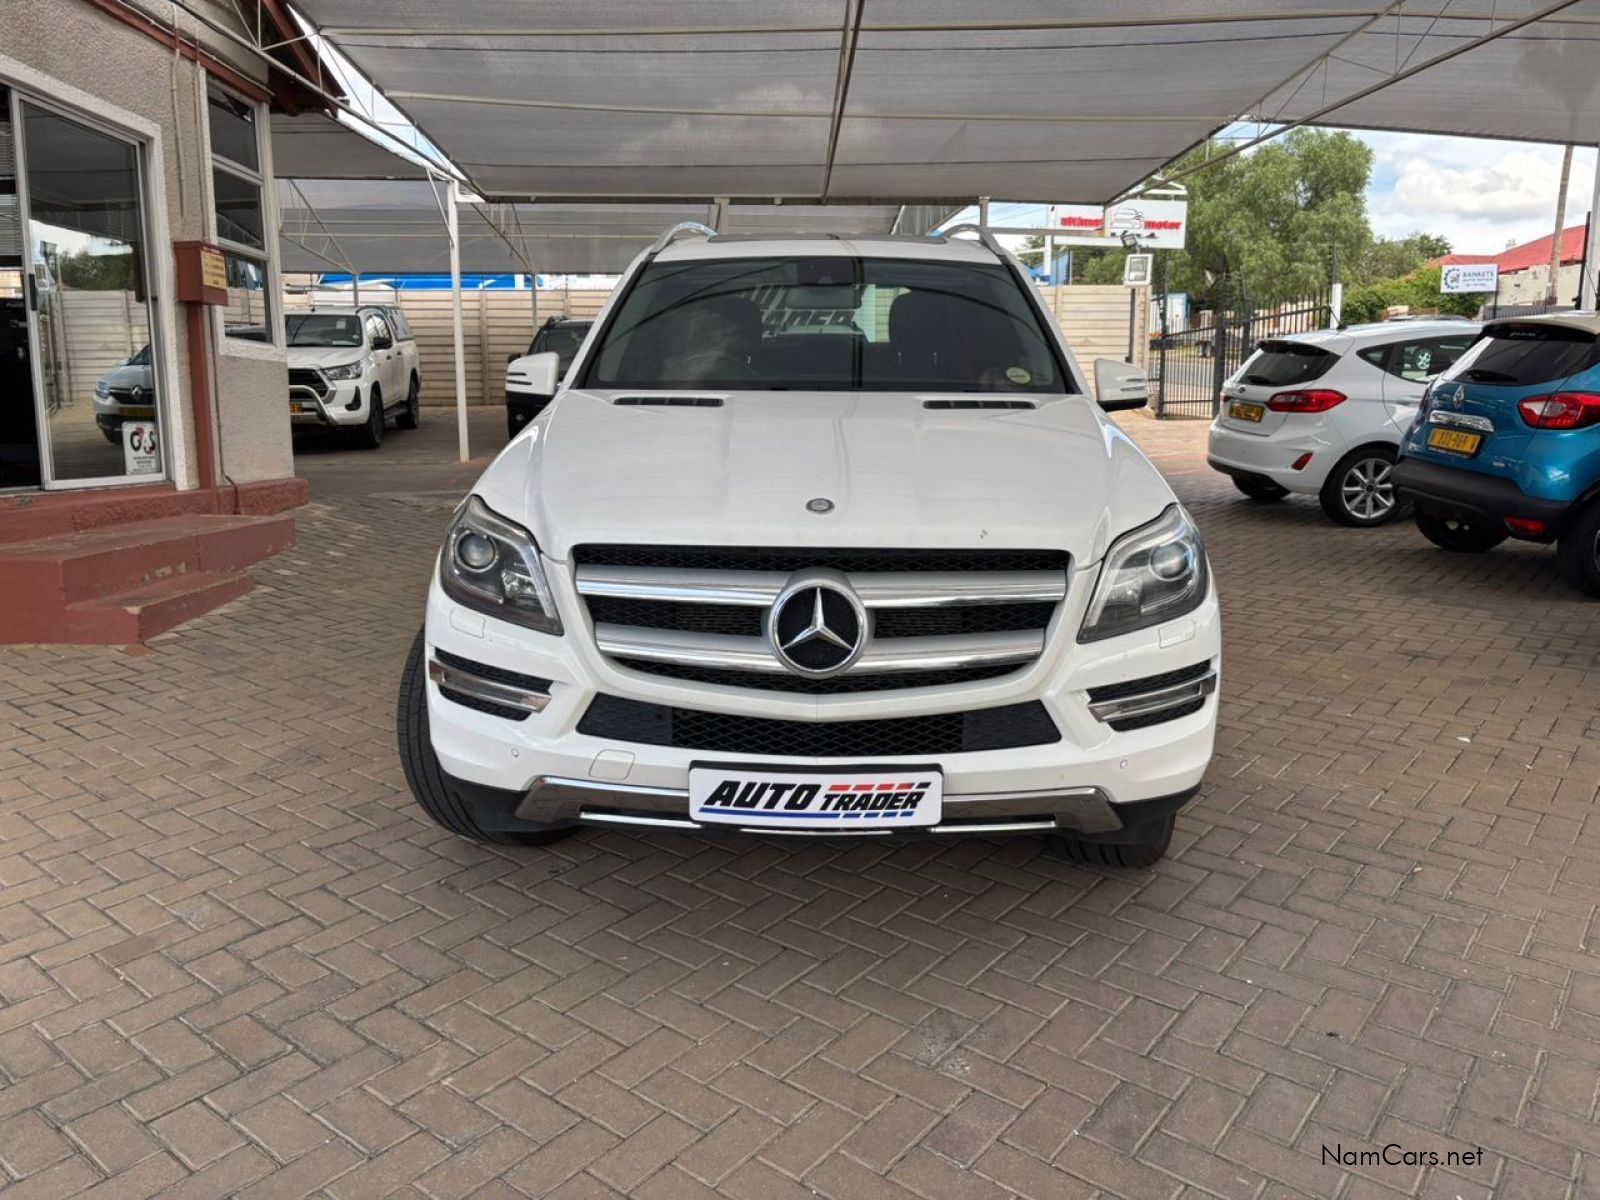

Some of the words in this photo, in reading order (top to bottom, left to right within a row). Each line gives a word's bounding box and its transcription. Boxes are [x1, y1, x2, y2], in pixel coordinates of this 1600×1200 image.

[1144, 219, 1182, 230] motor
[703, 780, 822, 811] AUTO
[820, 790, 926, 812] TRADER
